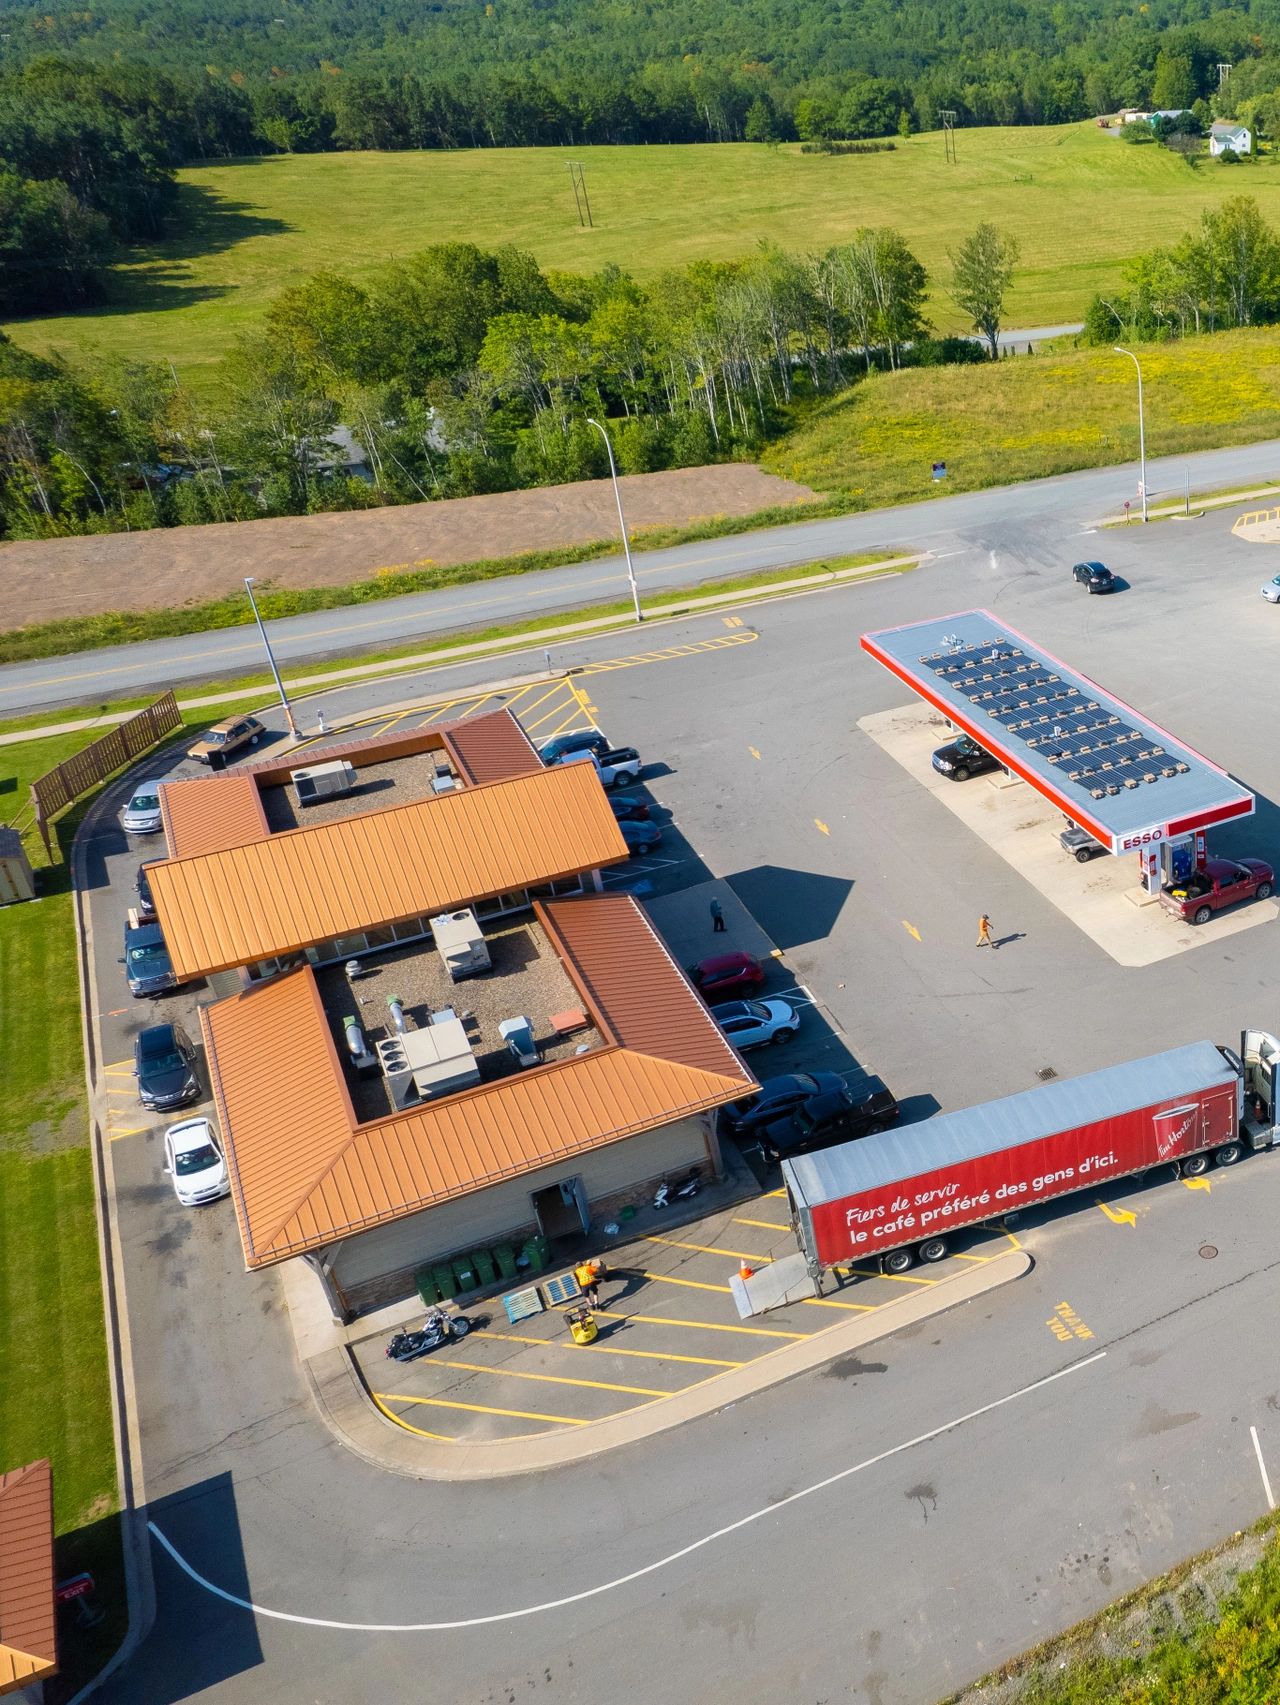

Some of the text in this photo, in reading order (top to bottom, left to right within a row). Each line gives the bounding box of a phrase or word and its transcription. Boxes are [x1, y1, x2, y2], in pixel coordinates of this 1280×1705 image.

[1123, 829, 1162, 851] ESSO
[1158, 1143, 1172, 1157] Tim
[846, 1181, 960, 1226] Fiers de servir
[850, 1229, 868, 1244] le
[872, 1213, 915, 1238] café
[921, 1191, 990, 1226] préféré
[995, 1181, 1028, 1200] des
[1032, 1167, 1075, 1192] gens
[1046, 1316, 1074, 1341] YOU
[1054, 1301, 1095, 1339] THANK
